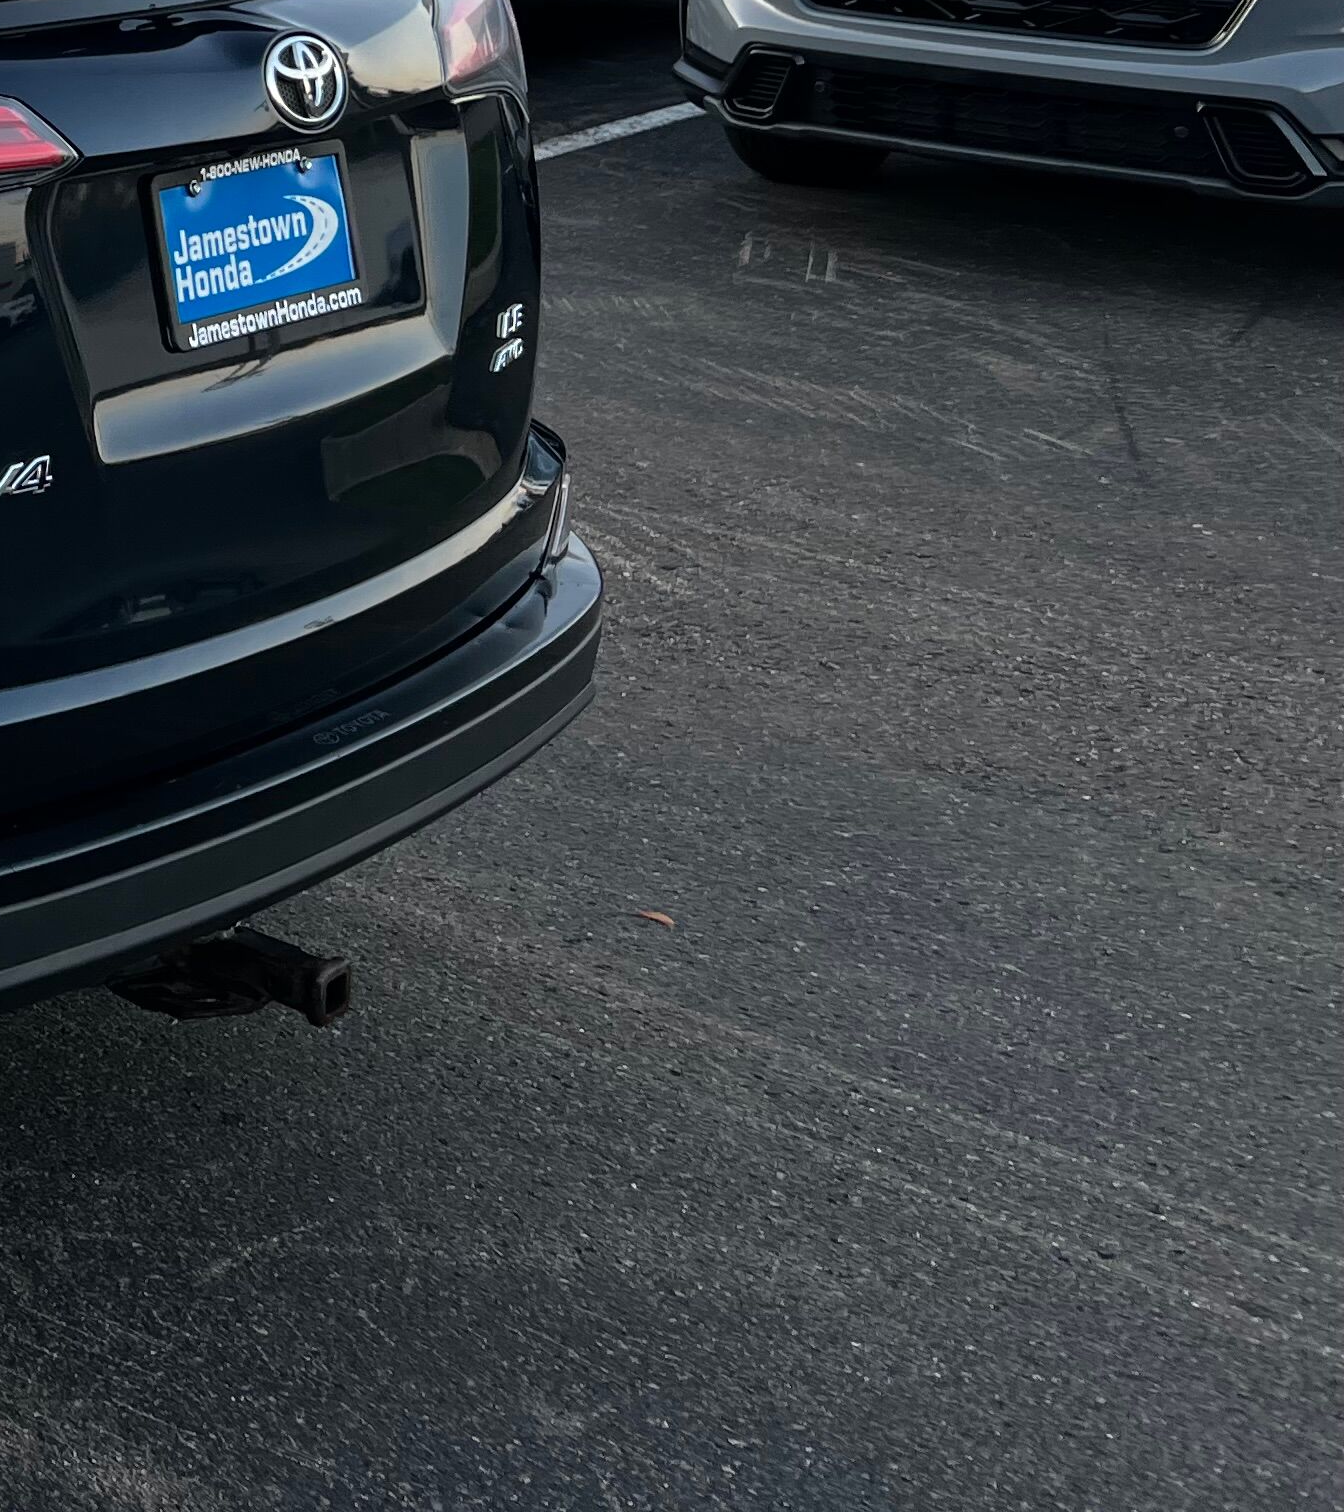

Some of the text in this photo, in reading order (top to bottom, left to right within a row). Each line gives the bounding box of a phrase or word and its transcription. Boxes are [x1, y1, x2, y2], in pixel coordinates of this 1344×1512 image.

[200, 148, 301, 182] 1-800-NEW-HONDA
[173, 211, 308, 265] Jamestown
[176, 254, 254, 303] Honda
[188, 287, 362, 348] JamestownHonda.com
